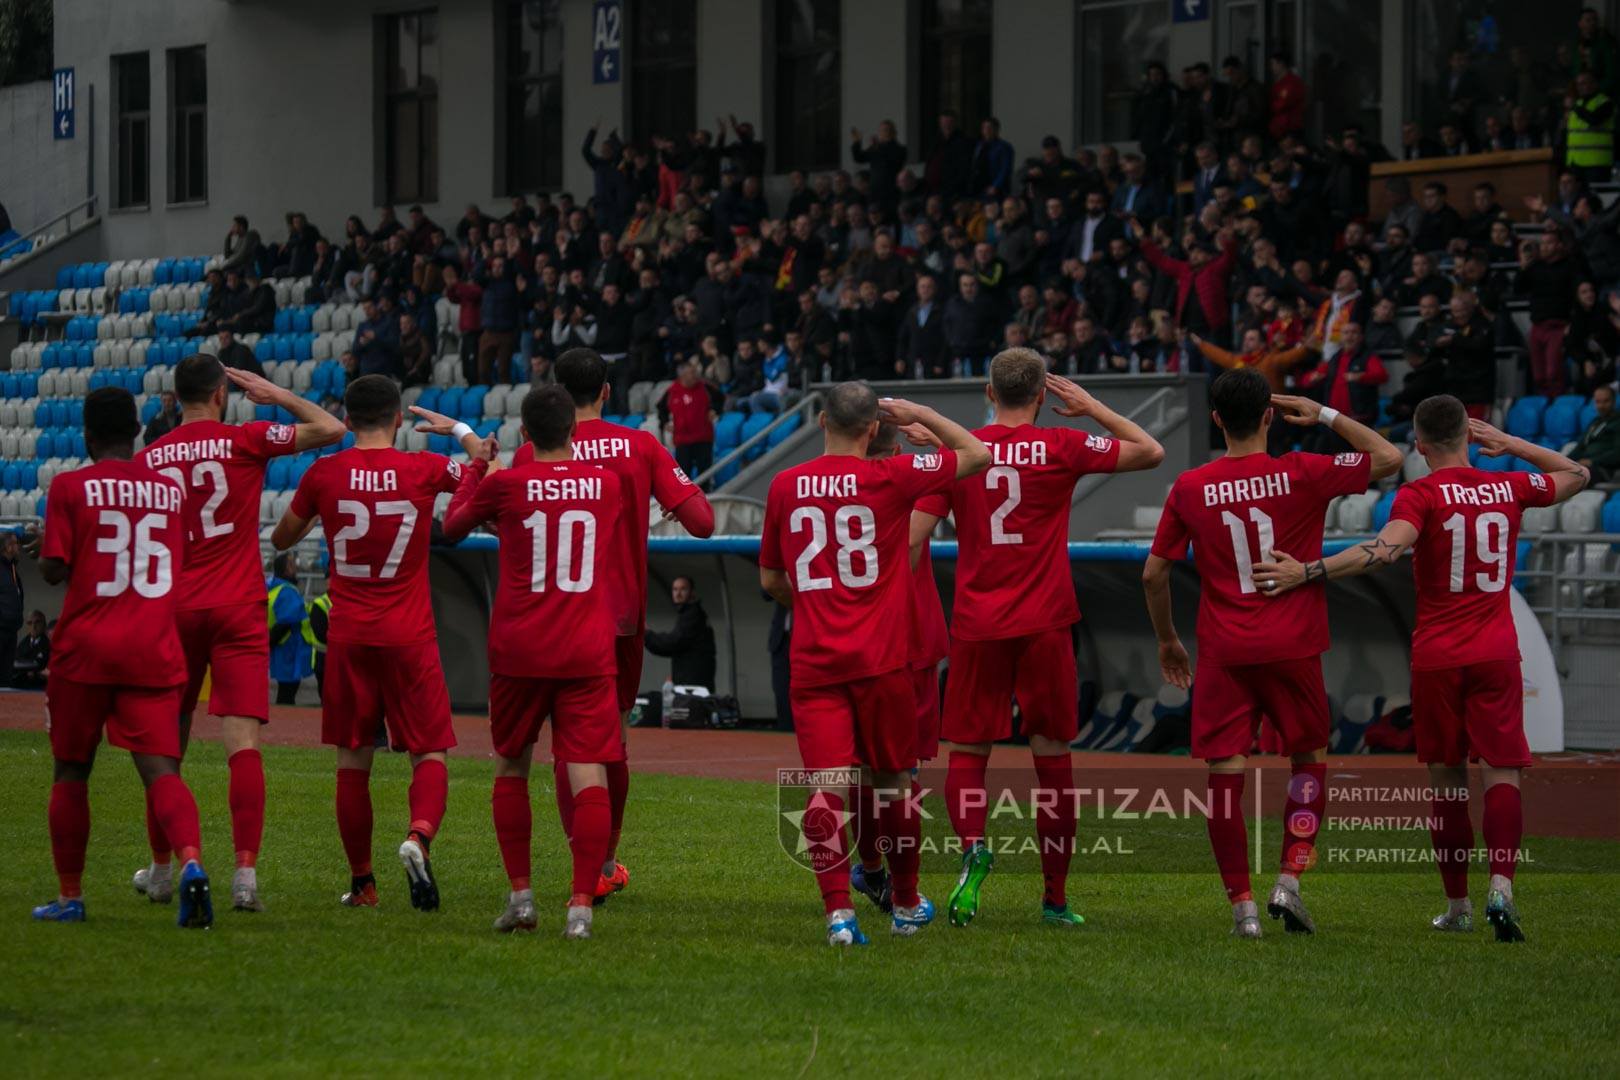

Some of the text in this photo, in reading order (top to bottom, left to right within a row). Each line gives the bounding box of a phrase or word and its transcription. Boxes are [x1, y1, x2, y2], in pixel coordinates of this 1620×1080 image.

[595, 6, 620, 50] A2
[55, 72, 72, 111] H1
[84, 480, 181, 514] ATANDA
[350, 468, 397, 492] HILA
[527, 477, 601, 501] ASANI
[797, 474, 857, 499] DUKA
[1204, 472, 1291, 507] BARDHI
[1439, 481, 1514, 506] TRASHI
[985, 466, 1023, 544] 2
[96, 510, 173, 598] 36
[333, 500, 418, 579] 27
[523, 510, 596, 593] 10
[790, 504, 879, 592] 28
[1221, 506, 1277, 594] 11
[1443, 511, 1509, 593] 19
